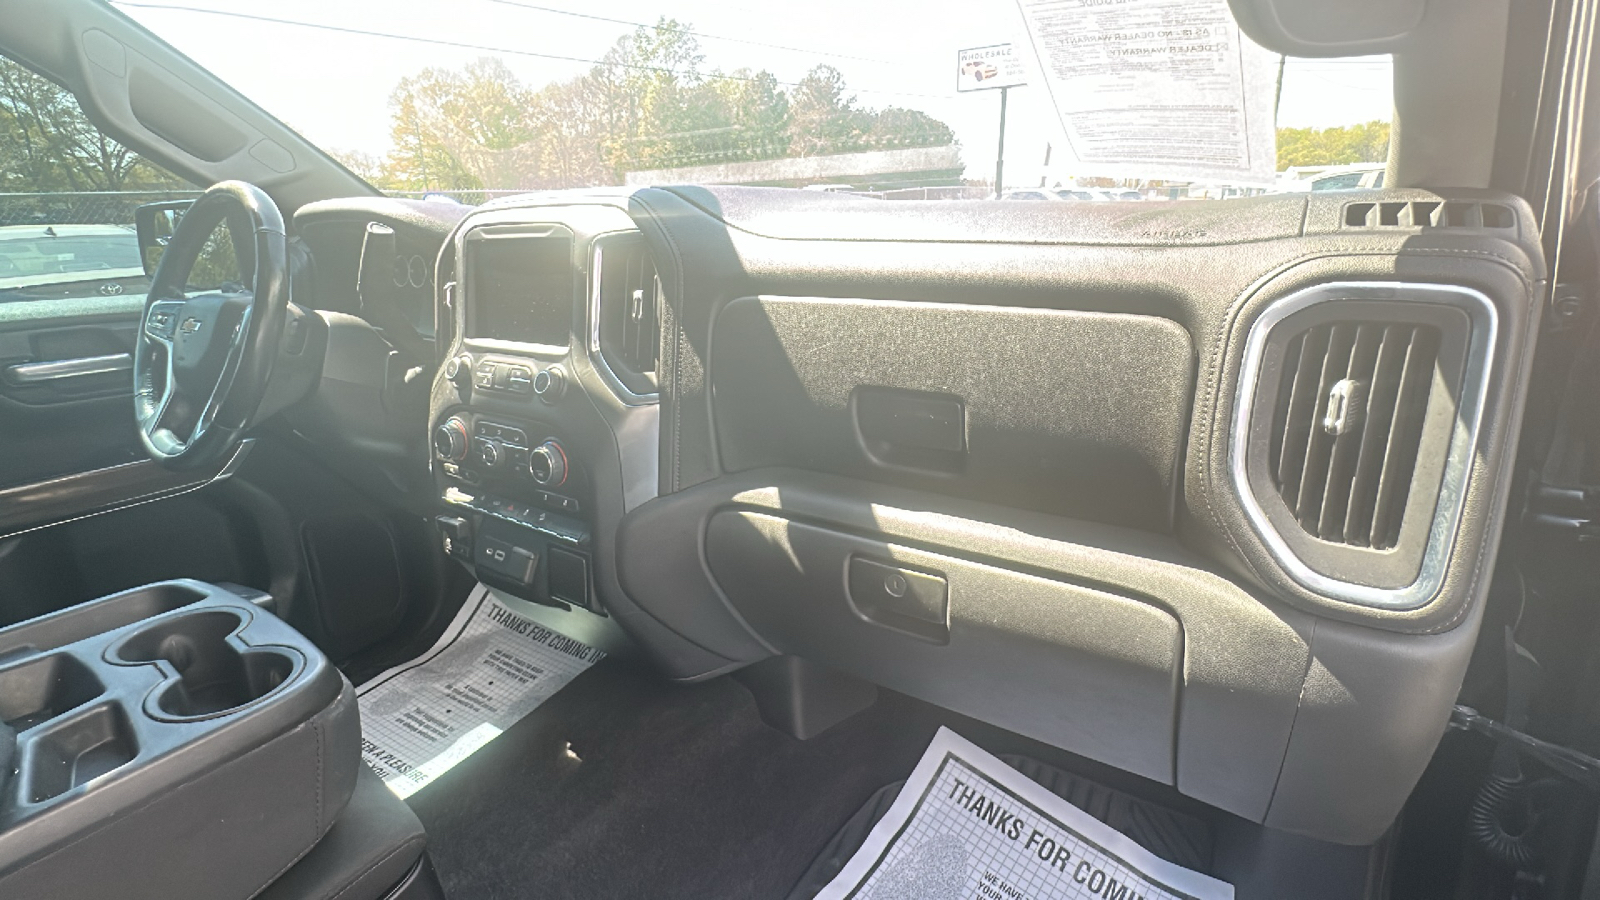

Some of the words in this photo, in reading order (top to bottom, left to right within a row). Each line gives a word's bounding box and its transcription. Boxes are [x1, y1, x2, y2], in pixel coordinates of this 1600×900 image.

[961, 48, 1012, 61] WHOLESALE
[488, 603, 531, 634] THANKS
[526, 625, 553, 644] FOR
[548, 634, 592, 660] COMING
[361, 738, 379, 753] EEN
[371, 750, 386, 758] A
[379, 754, 429, 784] PLEASURE
[948, 777, 1025, 842] THANKS
[1024, 827, 1071, 873] FOR
[977, 881, 1003, 900] YOUR
[984, 870, 999, 886] WE
[998, 881, 1024, 900] HAVE
